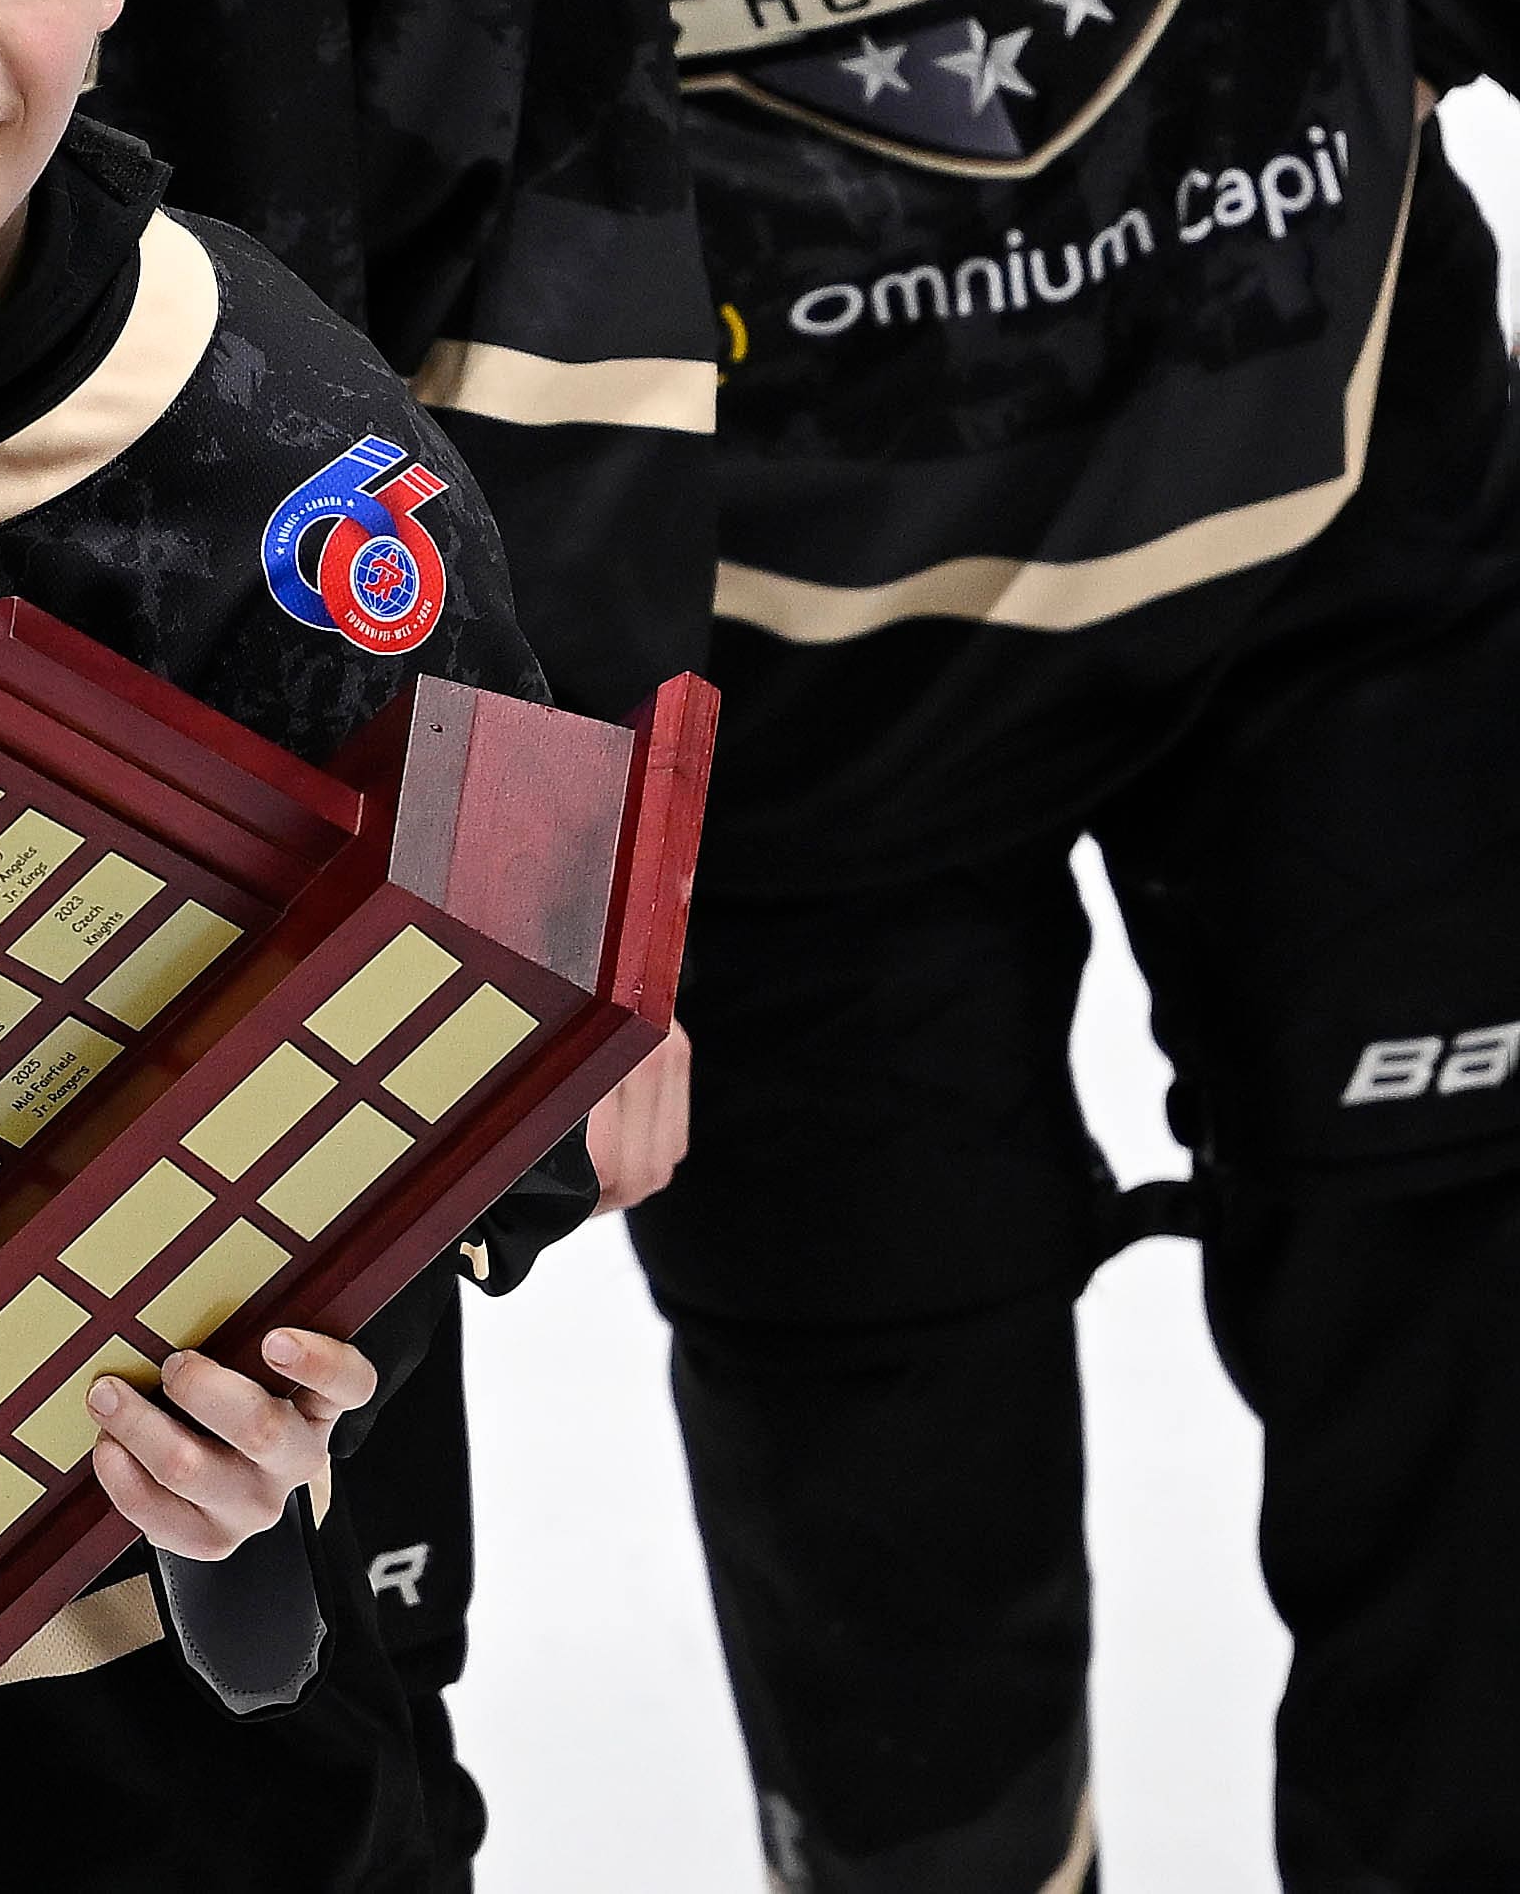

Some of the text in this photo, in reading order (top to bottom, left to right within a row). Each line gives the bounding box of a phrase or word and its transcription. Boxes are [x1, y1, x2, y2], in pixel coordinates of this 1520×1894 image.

[787, 206, 1155, 337] omnium
[2, 861, 49, 904] Jr. Kings
[54, 895, 85, 922] 2023
[71, 904, 104, 934] Czech
[83, 911, 123, 946] Knights
[11, 1058, 41, 1085] 2025
[11, 1051, 78, 1113] Mid Fairfield
[31, 1064, 90, 1119] Jr. Rangers
